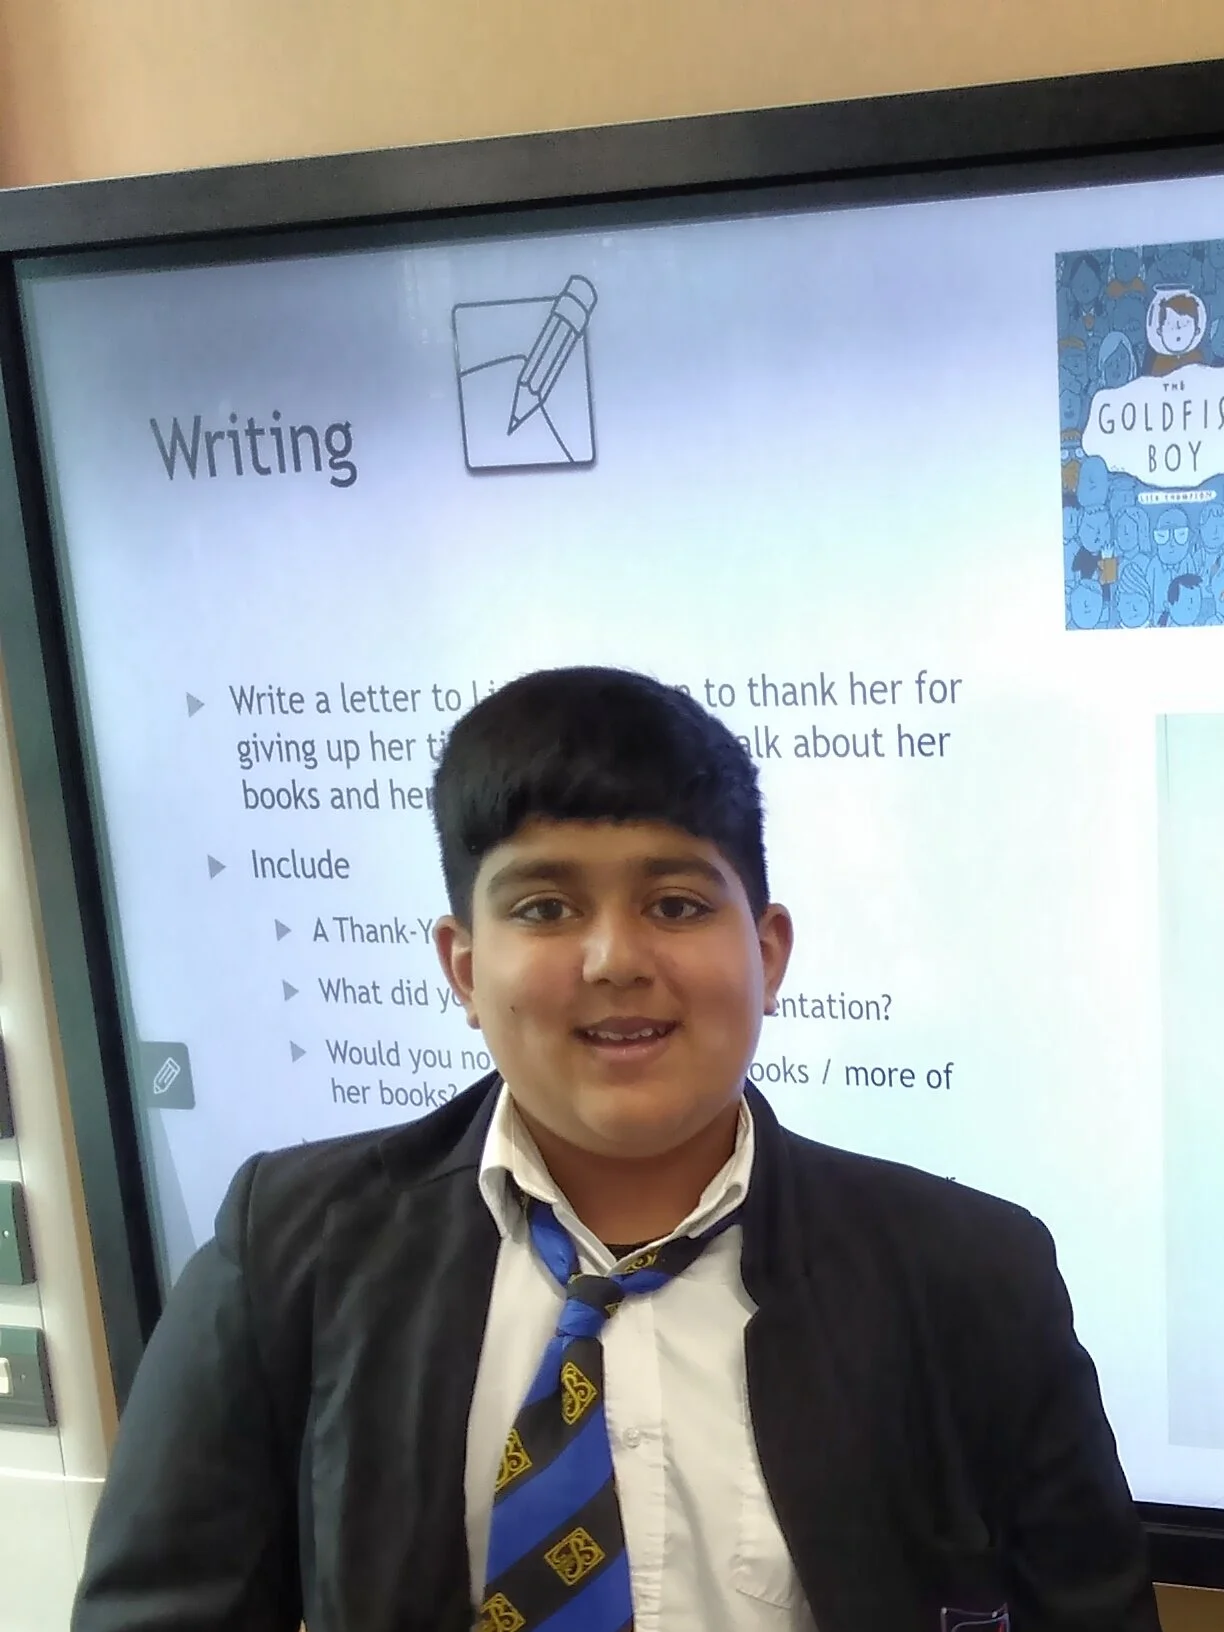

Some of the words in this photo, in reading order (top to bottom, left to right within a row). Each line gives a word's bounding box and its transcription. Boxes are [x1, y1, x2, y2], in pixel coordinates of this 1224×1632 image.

[1163, 382, 1186, 392] THE
[150, 411, 358, 488] Writing
[1147, 440, 1203, 474] BOY
[229, 685, 305, 715] Write
[315, 691, 332, 714] a
[340, 682, 421, 713] letter
[432, 683, 462, 712] to
[704, 678, 736, 708] to
[747, 673, 837, 707] thank
[849, 671, 902, 705] her
[915, 670, 963, 704] for
[237, 732, 316, 770] giving
[326, 738, 360, 769] up
[369, 730, 417, 762] her
[735, 725, 783, 759] alk
[794, 725, 885, 758] about
[897, 723, 951, 758] her
[242, 778, 321, 811] books
[330, 778, 380, 810] and
[251, 848, 350, 879] Include
[313, 917, 330, 942] A
[333, 916, 435, 944] Thank-Y
[318, 977, 383, 1005] What
[390, 979, 429, 1006] did
[436, 987, 461, 1013] yo
[774, 992, 893, 1021] ntation?
[325, 1039, 400, 1067] Would
[408, 1049, 452, 1075] you
[461, 1050, 492, 1071] no
[749, 1055, 810, 1084] ooks
[822, 1058, 832, 1085] /
[844, 1062, 916, 1088] more
[926, 1062, 955, 1090] of
[331, 1078, 371, 1104] her
[379, 1080, 458, 1107] books?
